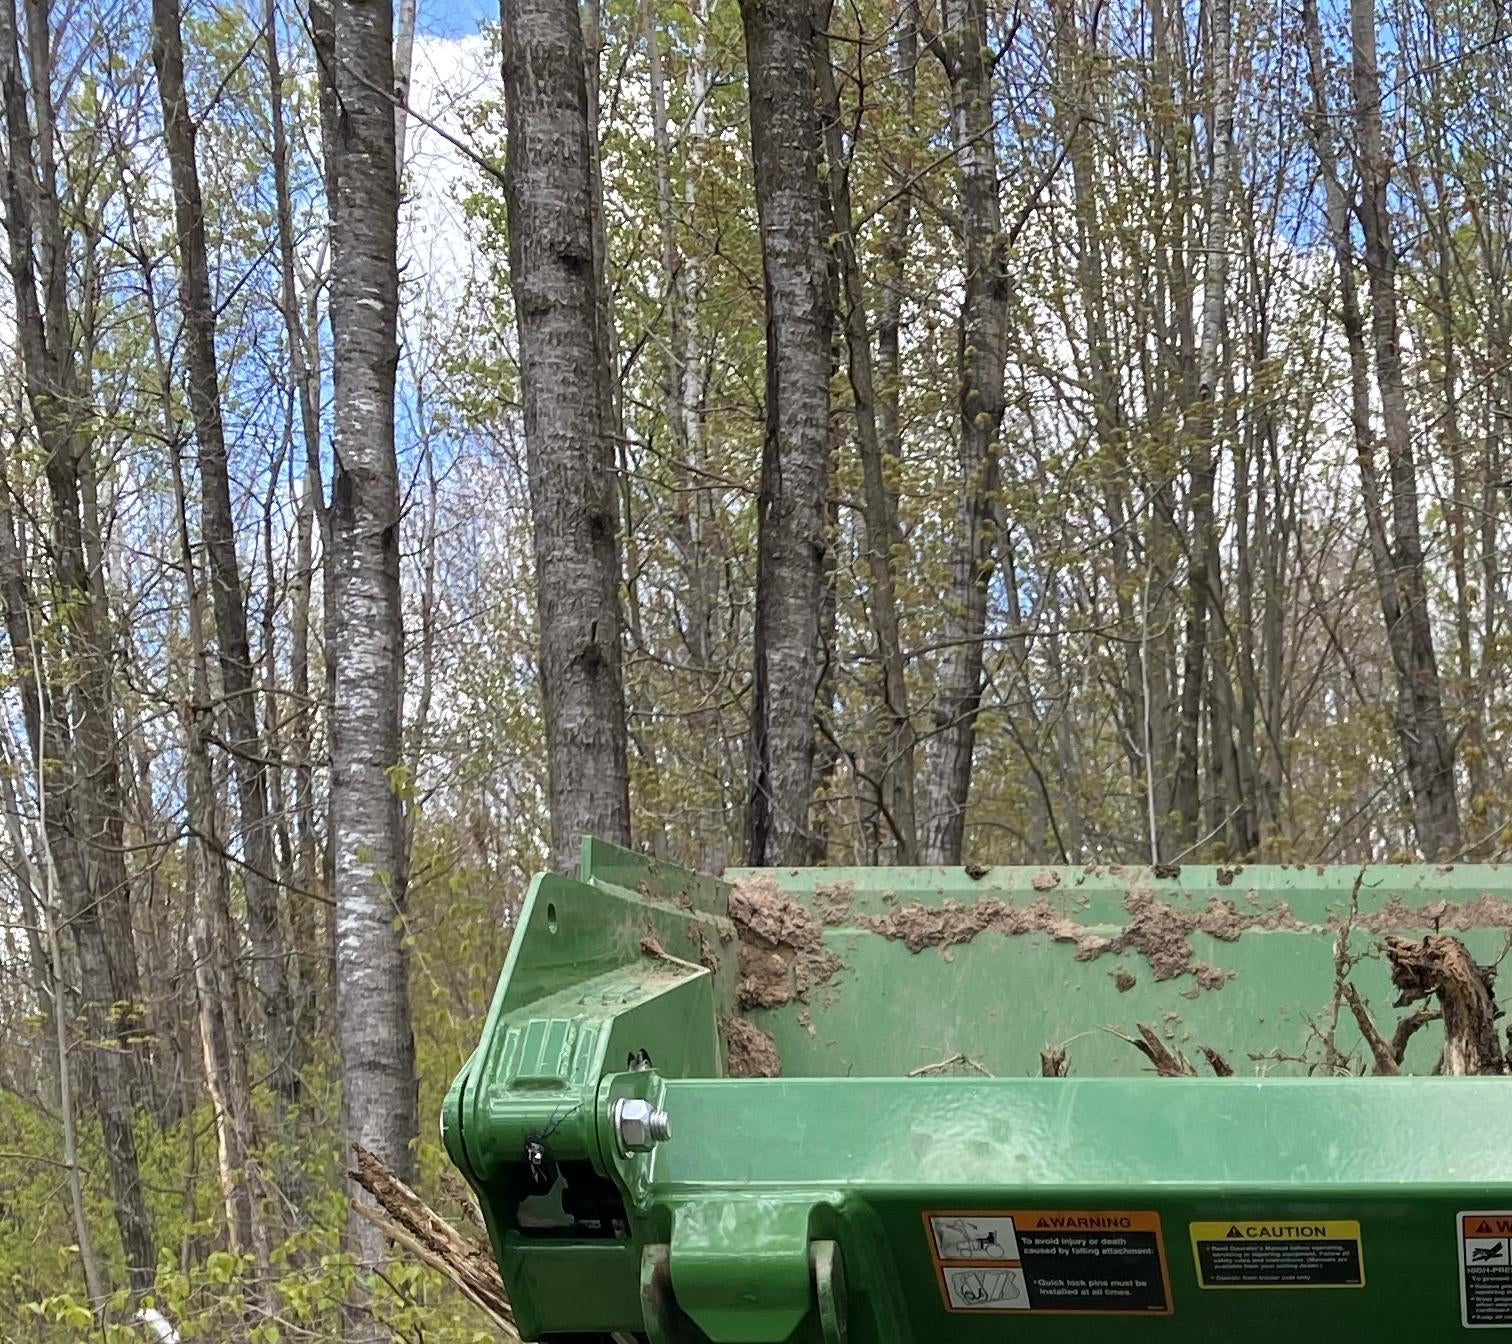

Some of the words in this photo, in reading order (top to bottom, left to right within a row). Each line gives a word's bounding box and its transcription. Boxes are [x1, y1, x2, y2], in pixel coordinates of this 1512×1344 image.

[1050, 1217, 1131, 1228] WARNING
[1246, 1226, 1327, 1238] CAUTION
[1021, 1237, 1032, 1245] To
[1034, 1237, 1059, 1245] avoid
[1061, 1237, 1087, 1247] injury
[1101, 1237, 1127, 1245] death
[1058, 1247, 1069, 1256] by
[1071, 1247, 1100, 1256] falling
[1088, 1279, 1109, 1288] pins
[1110, 1279, 1133, 1287] must
[1135, 1279, 1147, 1287] be
